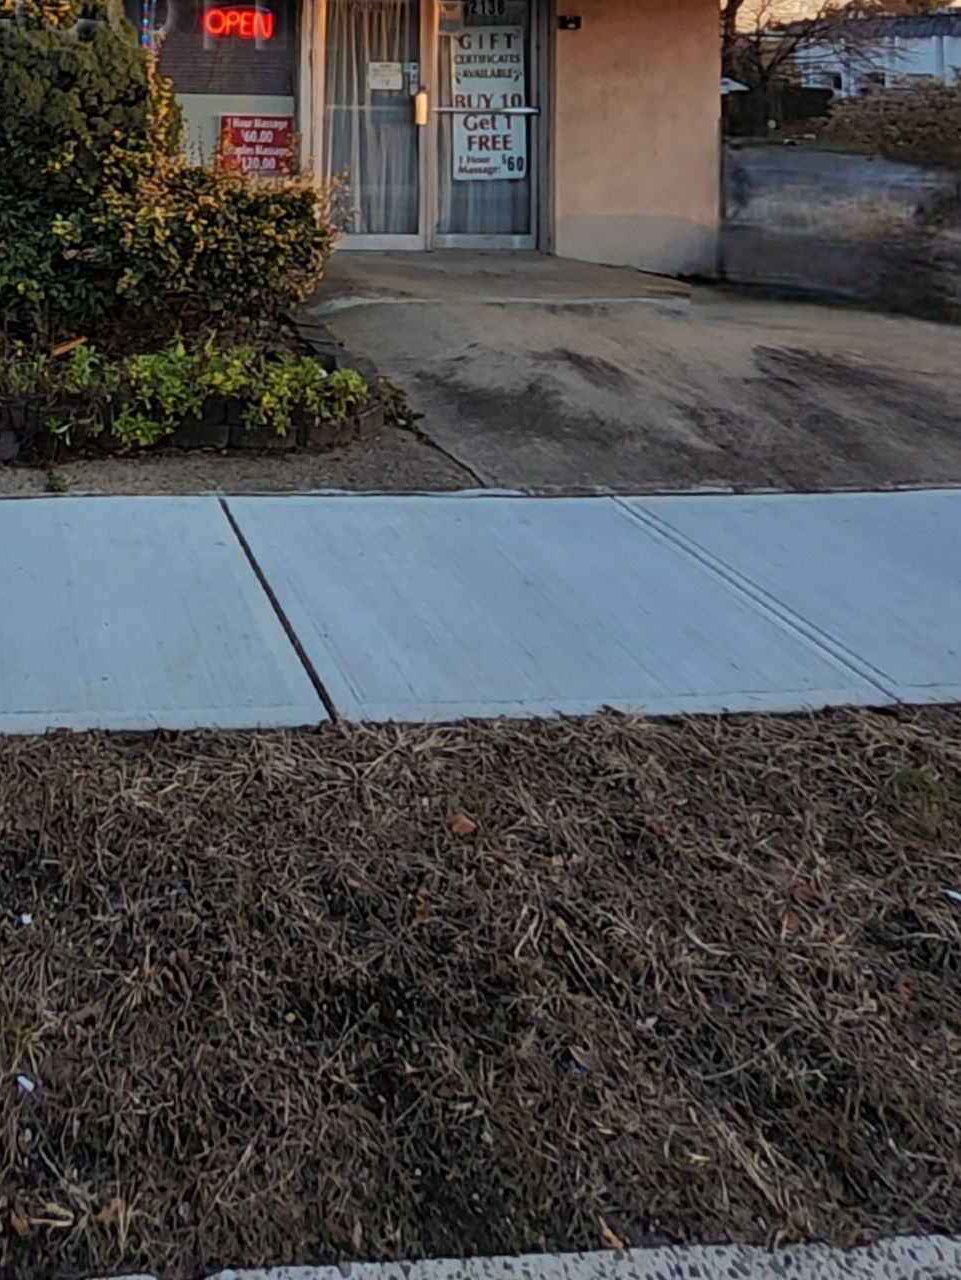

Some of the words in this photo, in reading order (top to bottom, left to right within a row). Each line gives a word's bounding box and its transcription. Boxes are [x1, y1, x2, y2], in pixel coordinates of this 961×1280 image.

[205, 7, 274, 40] OPEN
[459, 32, 514, 50] GIFT
[454, 53, 521, 65] CERTIFICATES
[462, 68, 513, 79] AVAILABLE
[501, 92, 523, 109] 10
[463, 112, 497, 131] Get
[467, 134, 513, 151] FREE
[501, 153, 524, 171] $60
